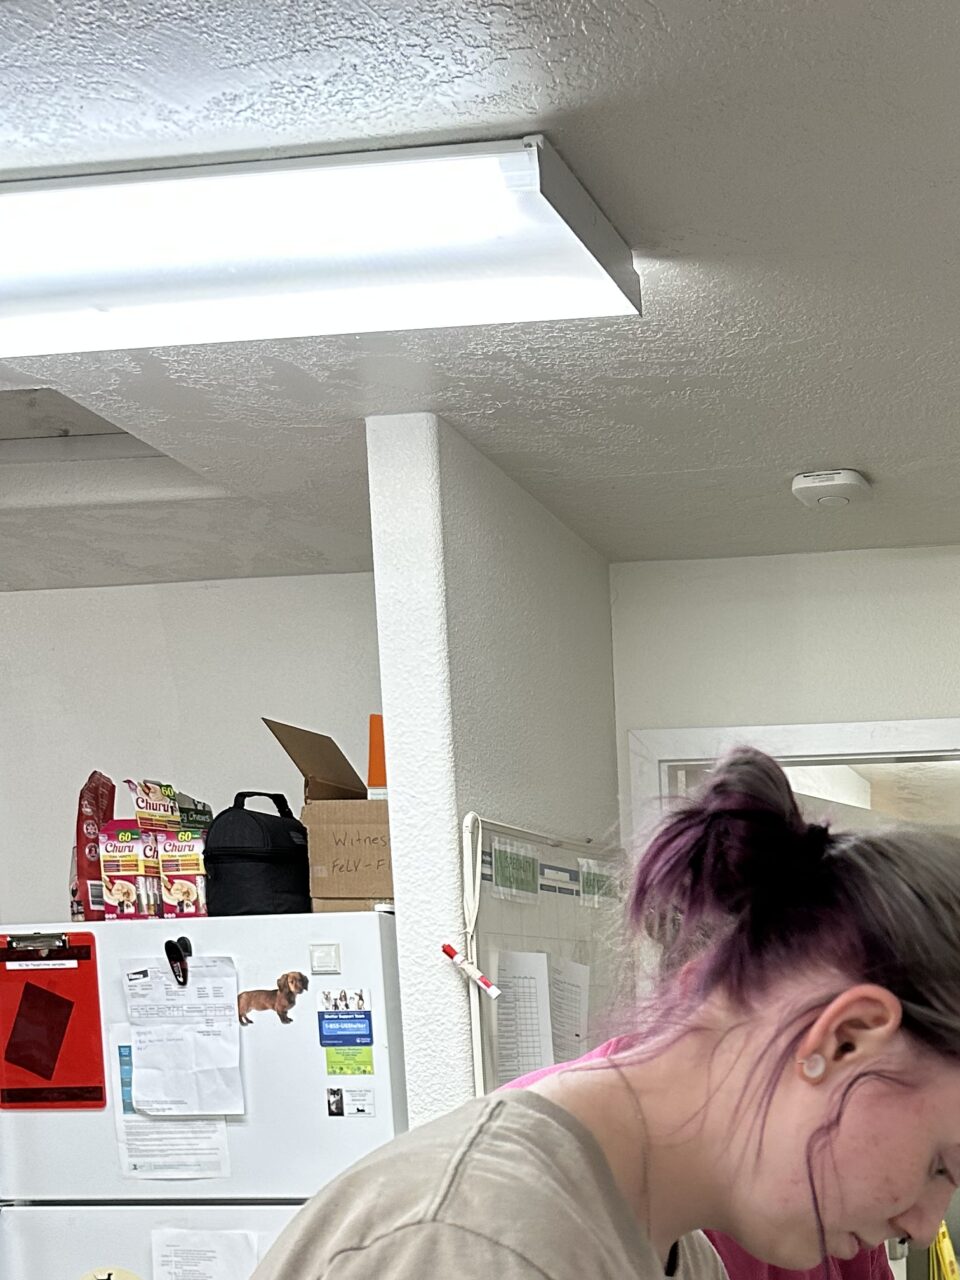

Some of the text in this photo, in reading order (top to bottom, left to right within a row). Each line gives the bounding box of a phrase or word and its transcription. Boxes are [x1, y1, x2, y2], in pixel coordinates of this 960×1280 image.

[162, 787, 174, 796] 60
[136, 797, 169, 812] Churu
[119, 832, 131, 842] 60
[178, 832, 191, 842] 60
[333, 832, 388, 847] Witnes
[105, 843, 134, 853] Churu
[164, 842, 195, 853] Churu
